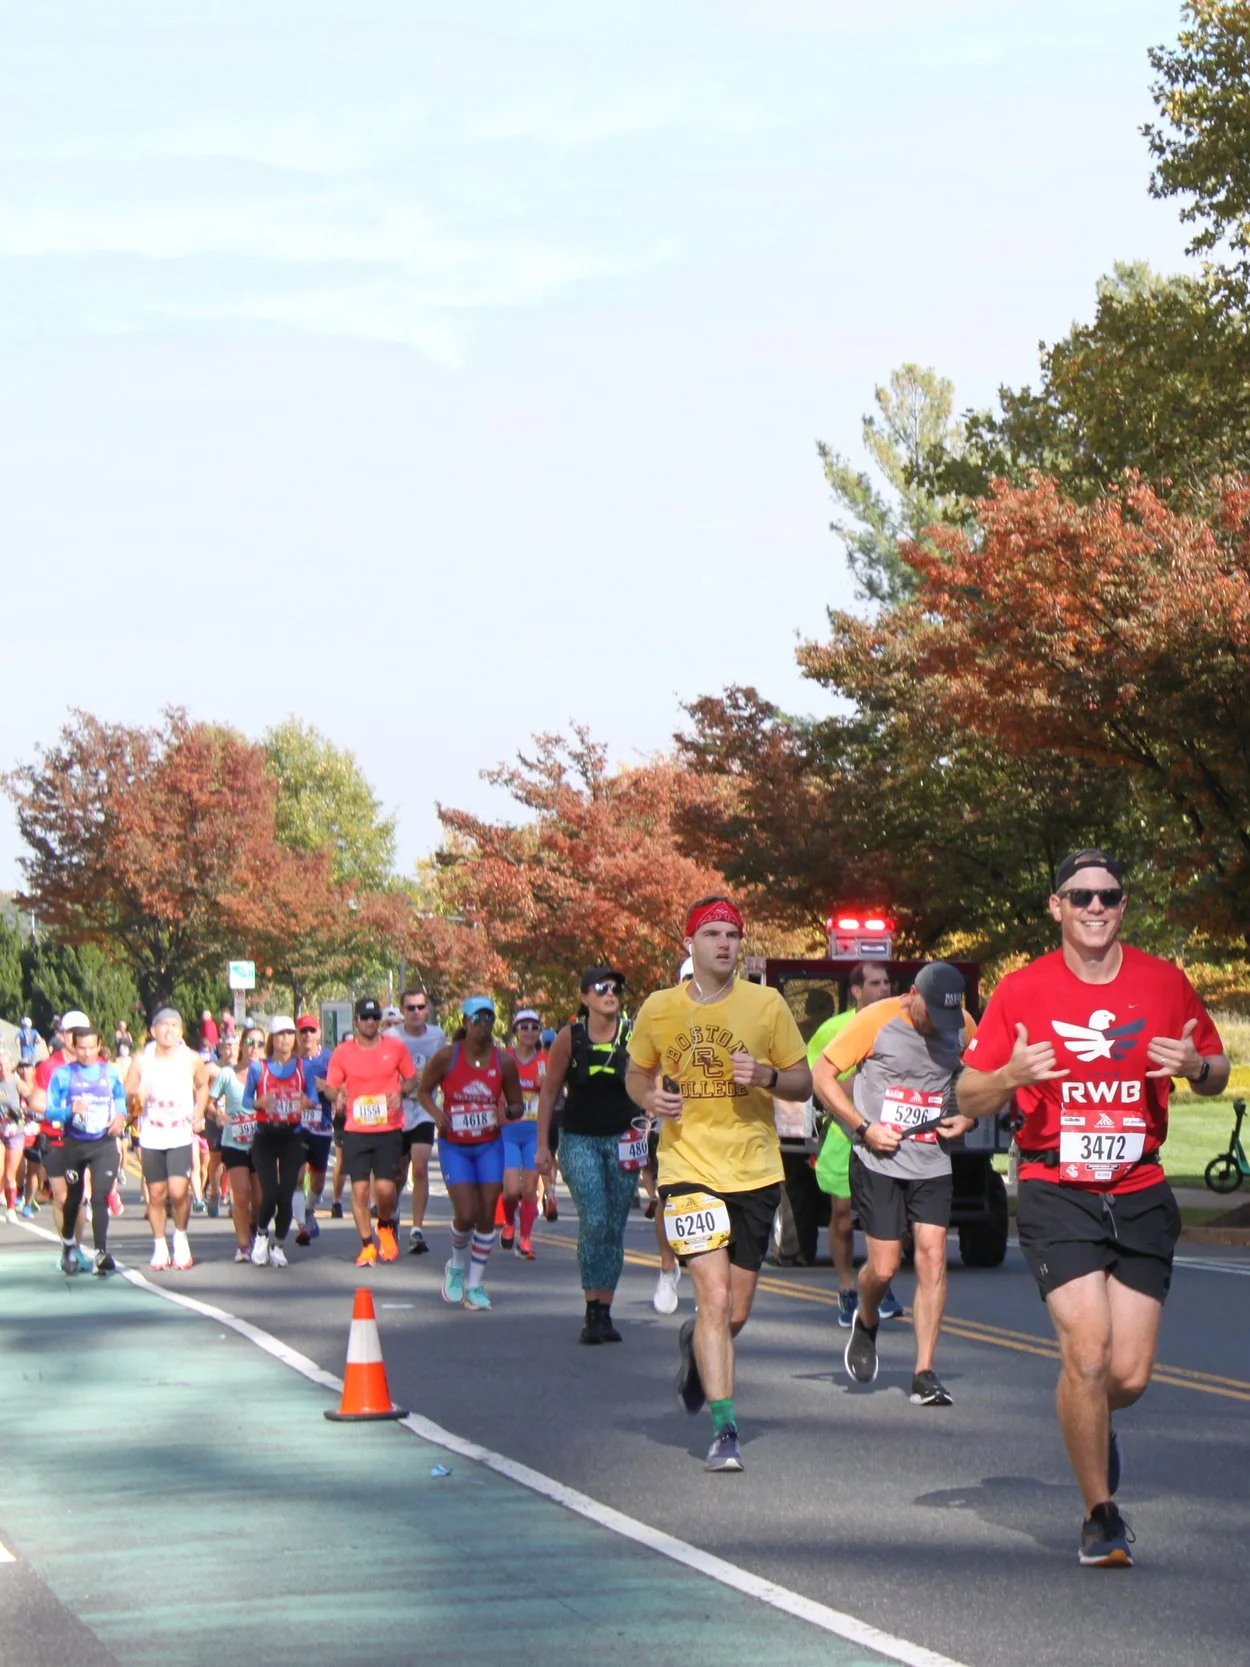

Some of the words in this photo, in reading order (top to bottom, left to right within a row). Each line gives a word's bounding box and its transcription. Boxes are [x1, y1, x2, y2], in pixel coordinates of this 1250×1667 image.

[666, 1024, 749, 1064] BOSTON
[679, 1080, 749, 1098] OLLEGE
[1062, 1081, 1141, 1103] RWB
[463, 1113, 488, 1128] 4618
[895, 1105, 929, 1125] 5296
[1080, 1135, 1127, 1161] 3472
[675, 1211, 716, 1238] 6240
